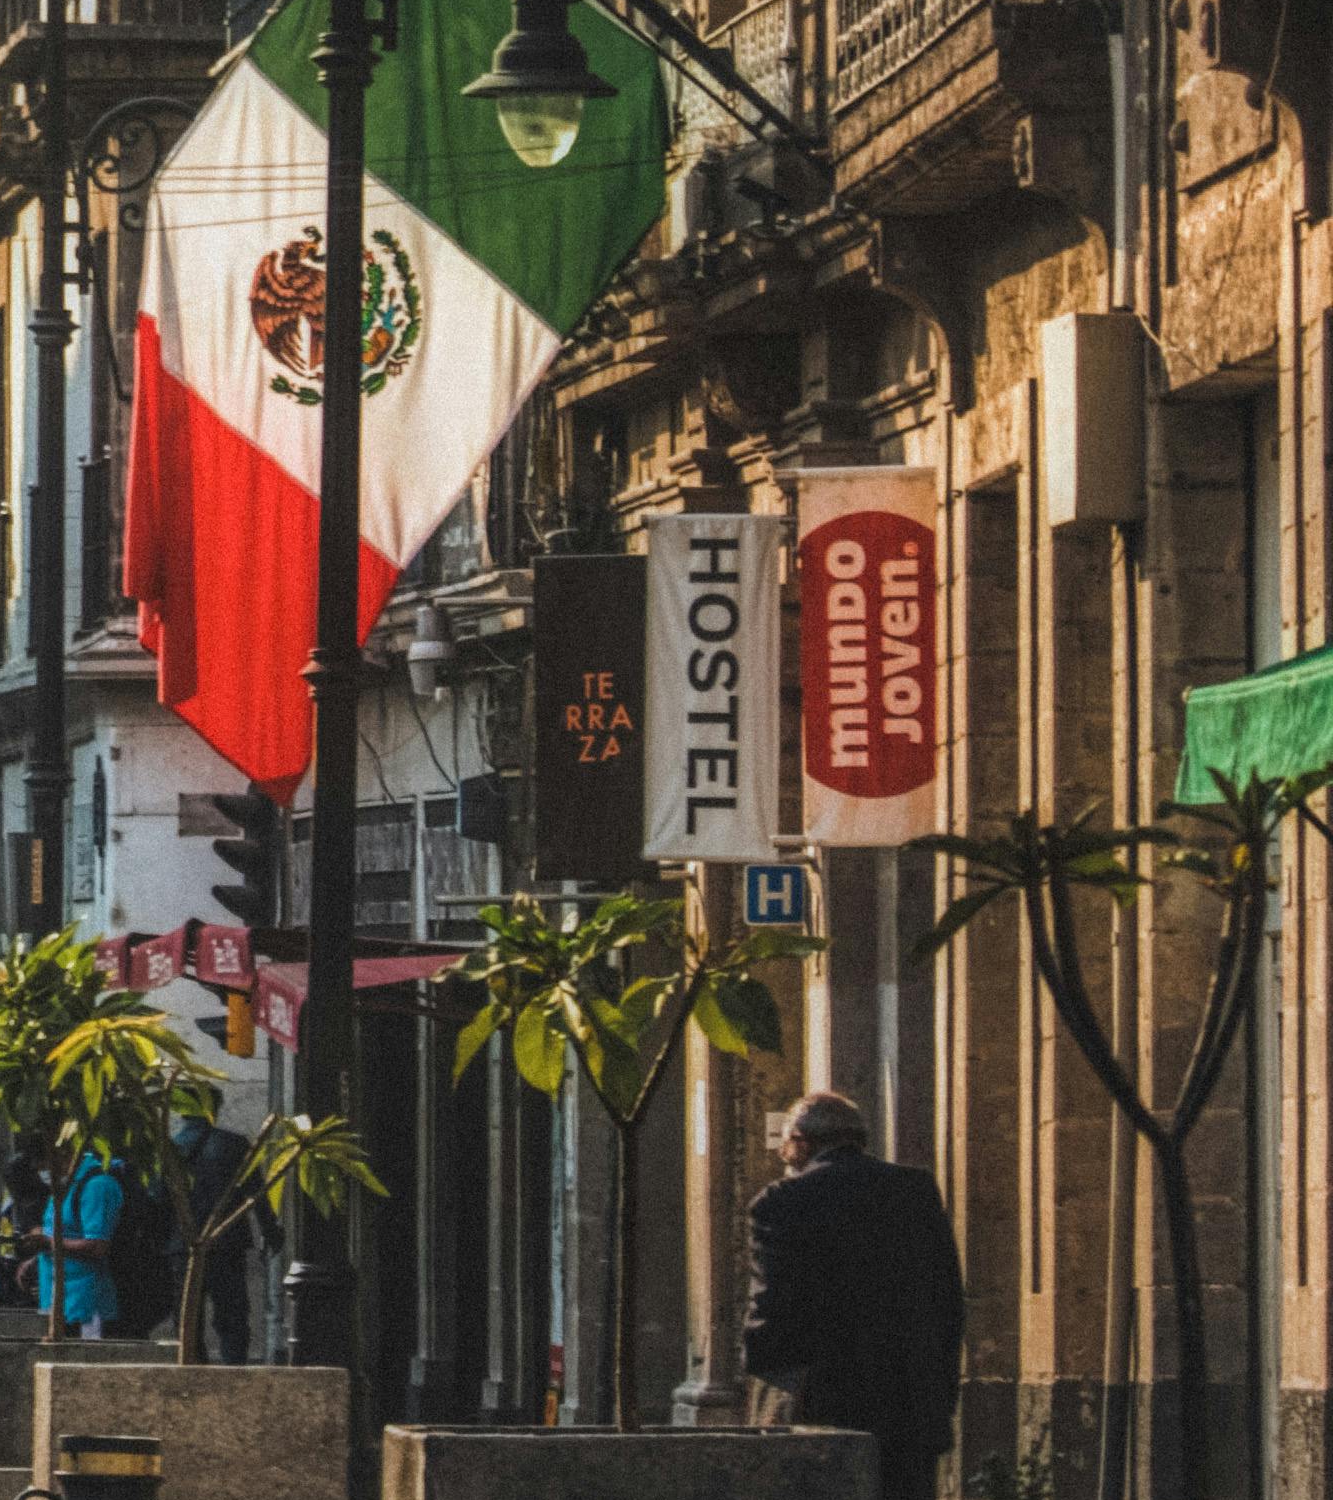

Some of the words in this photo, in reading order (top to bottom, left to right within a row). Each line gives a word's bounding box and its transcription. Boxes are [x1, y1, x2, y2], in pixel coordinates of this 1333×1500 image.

[582, 672, 614, 700] TE
[686, 537, 740, 836] HOSTEL
[565, 703, 634, 731] RRA
[578, 735, 622, 763] ZA
